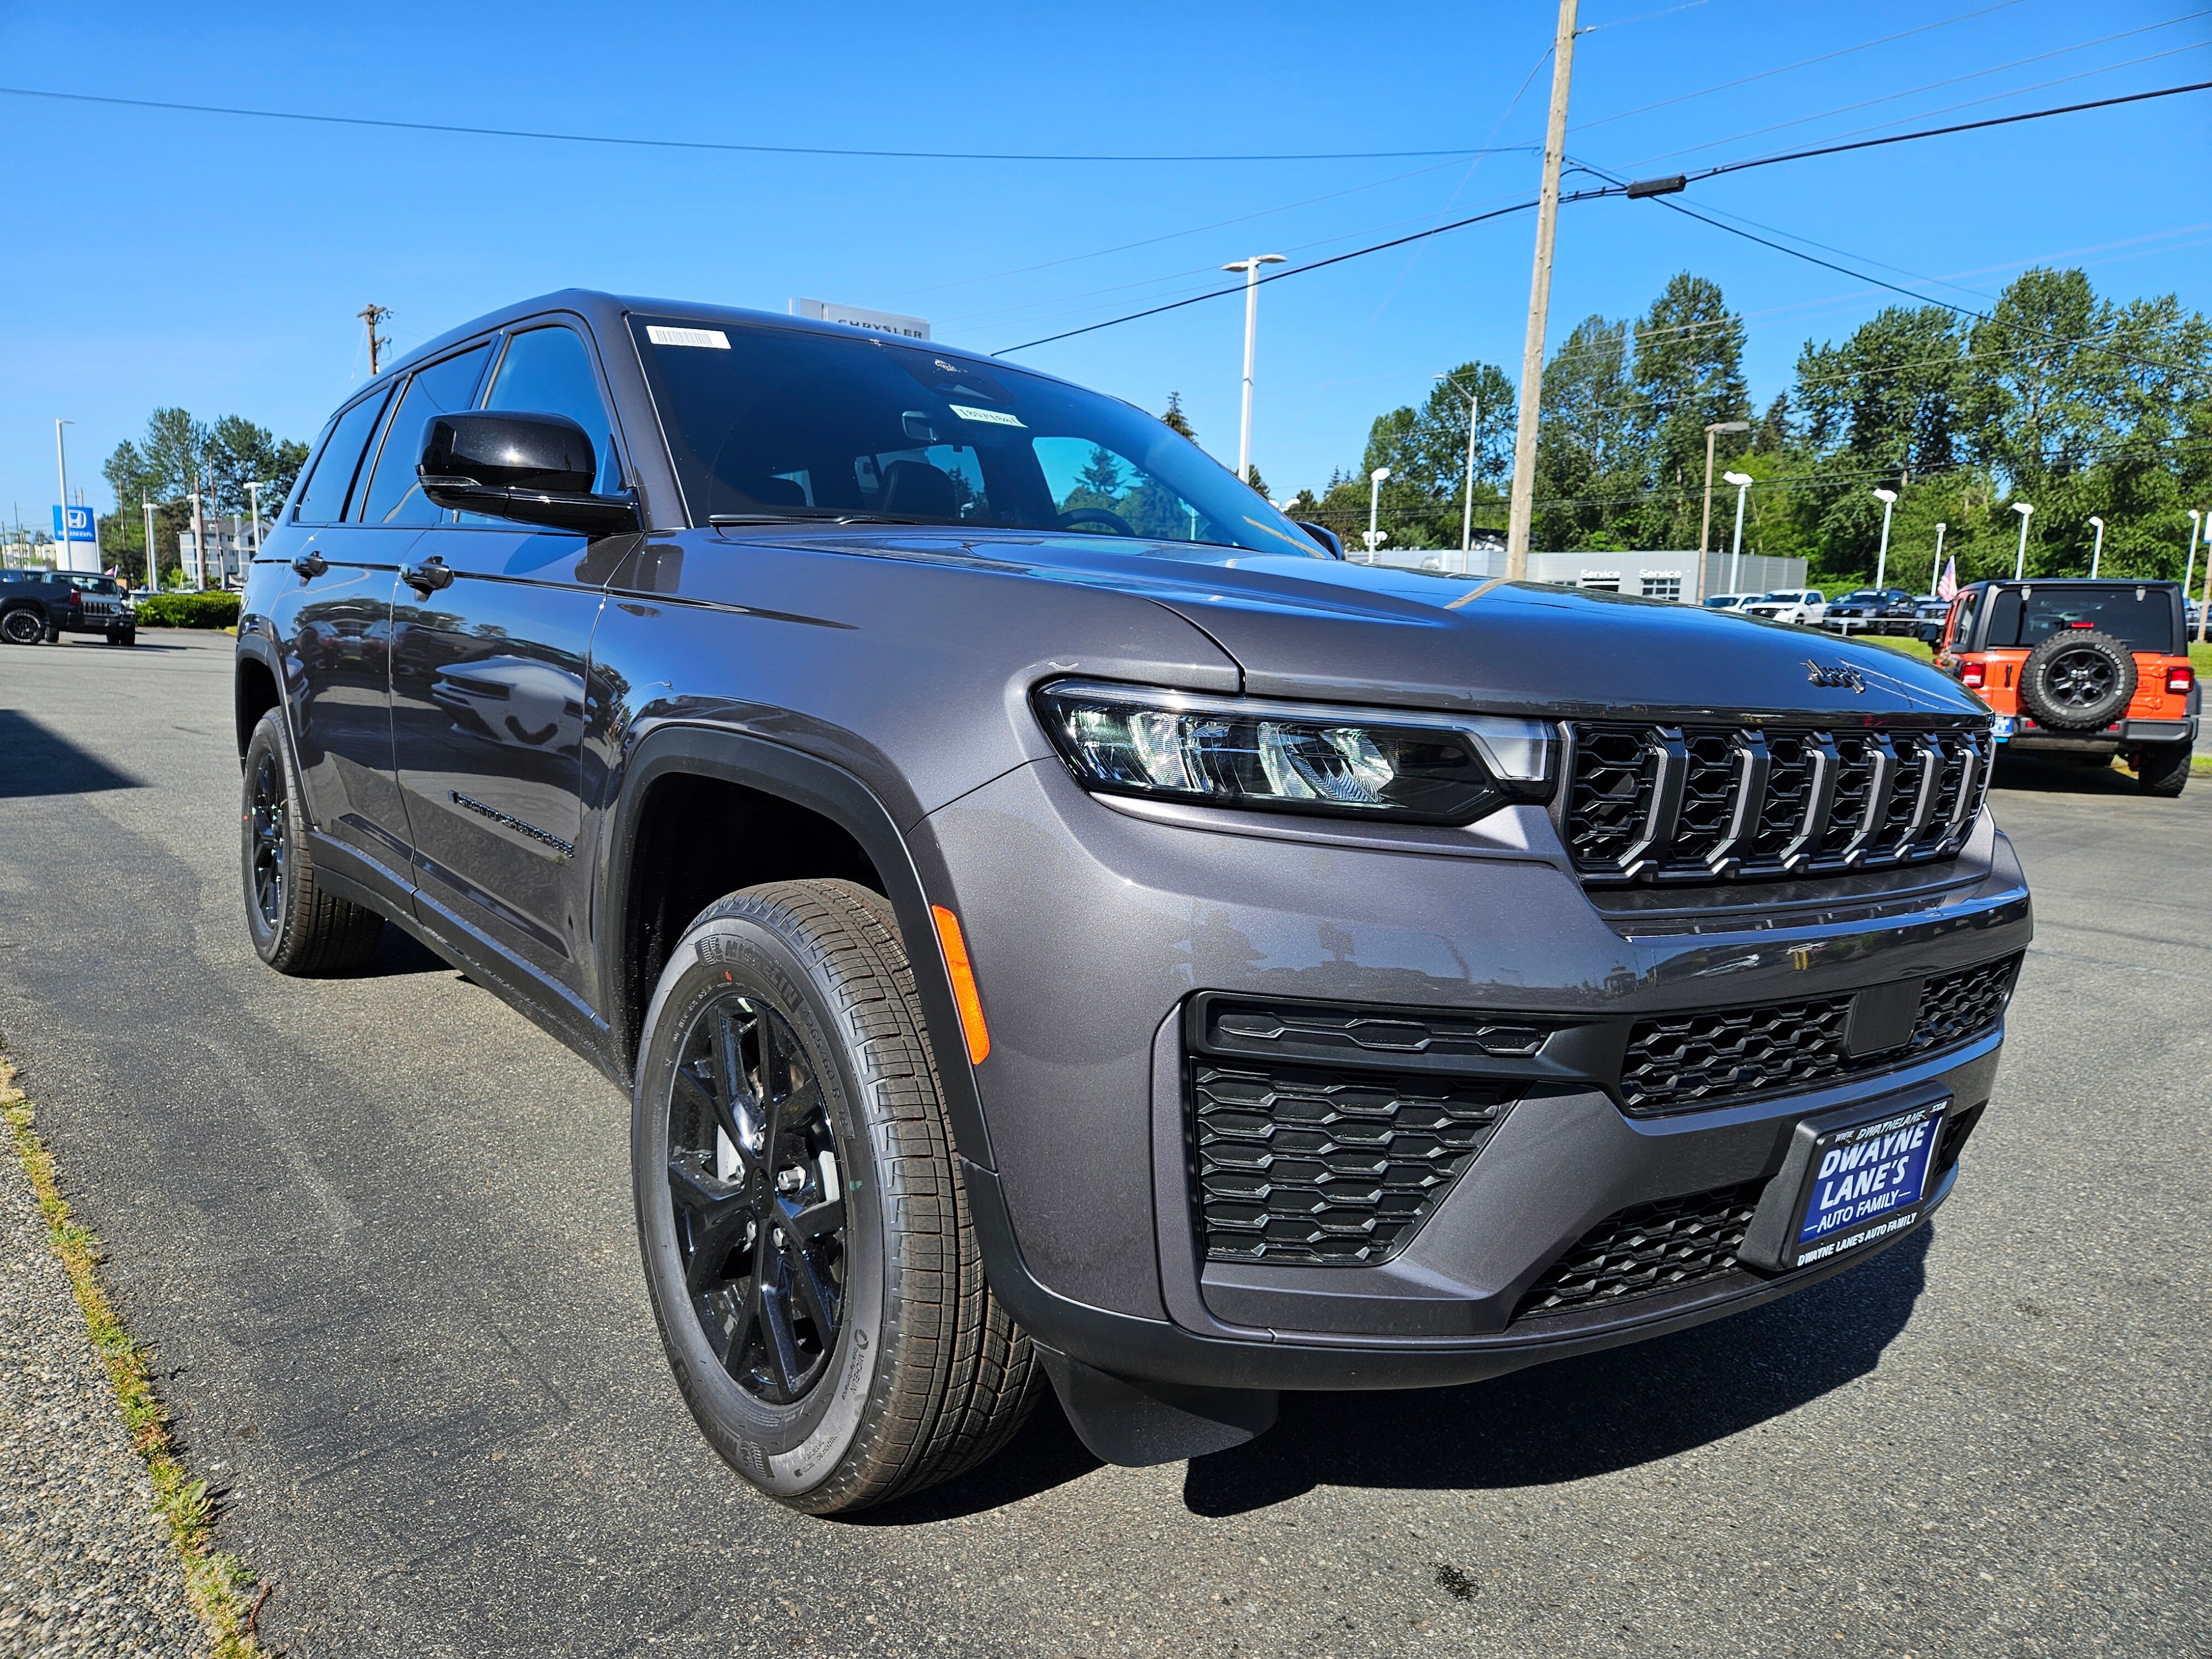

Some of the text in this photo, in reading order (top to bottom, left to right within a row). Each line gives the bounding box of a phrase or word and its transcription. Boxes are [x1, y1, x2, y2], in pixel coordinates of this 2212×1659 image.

[1580, 568, 1621, 578] Service
[1639, 568, 1683, 578] Service
[1807, 659, 1866, 694] Jeep
[1856, 1110, 1926, 1140] DWAYNELANE
[1818, 1120, 1930, 1180] DWAYNE
[1820, 1155, 1910, 1211] LANE'S
[1817, 1189, 1900, 1233] AUTO FAMILY
[1797, 1212, 1918, 1266] DWAYNE LANE'S AUTO FAMILY
[851, 1352, 864, 1395] MICHELIN
